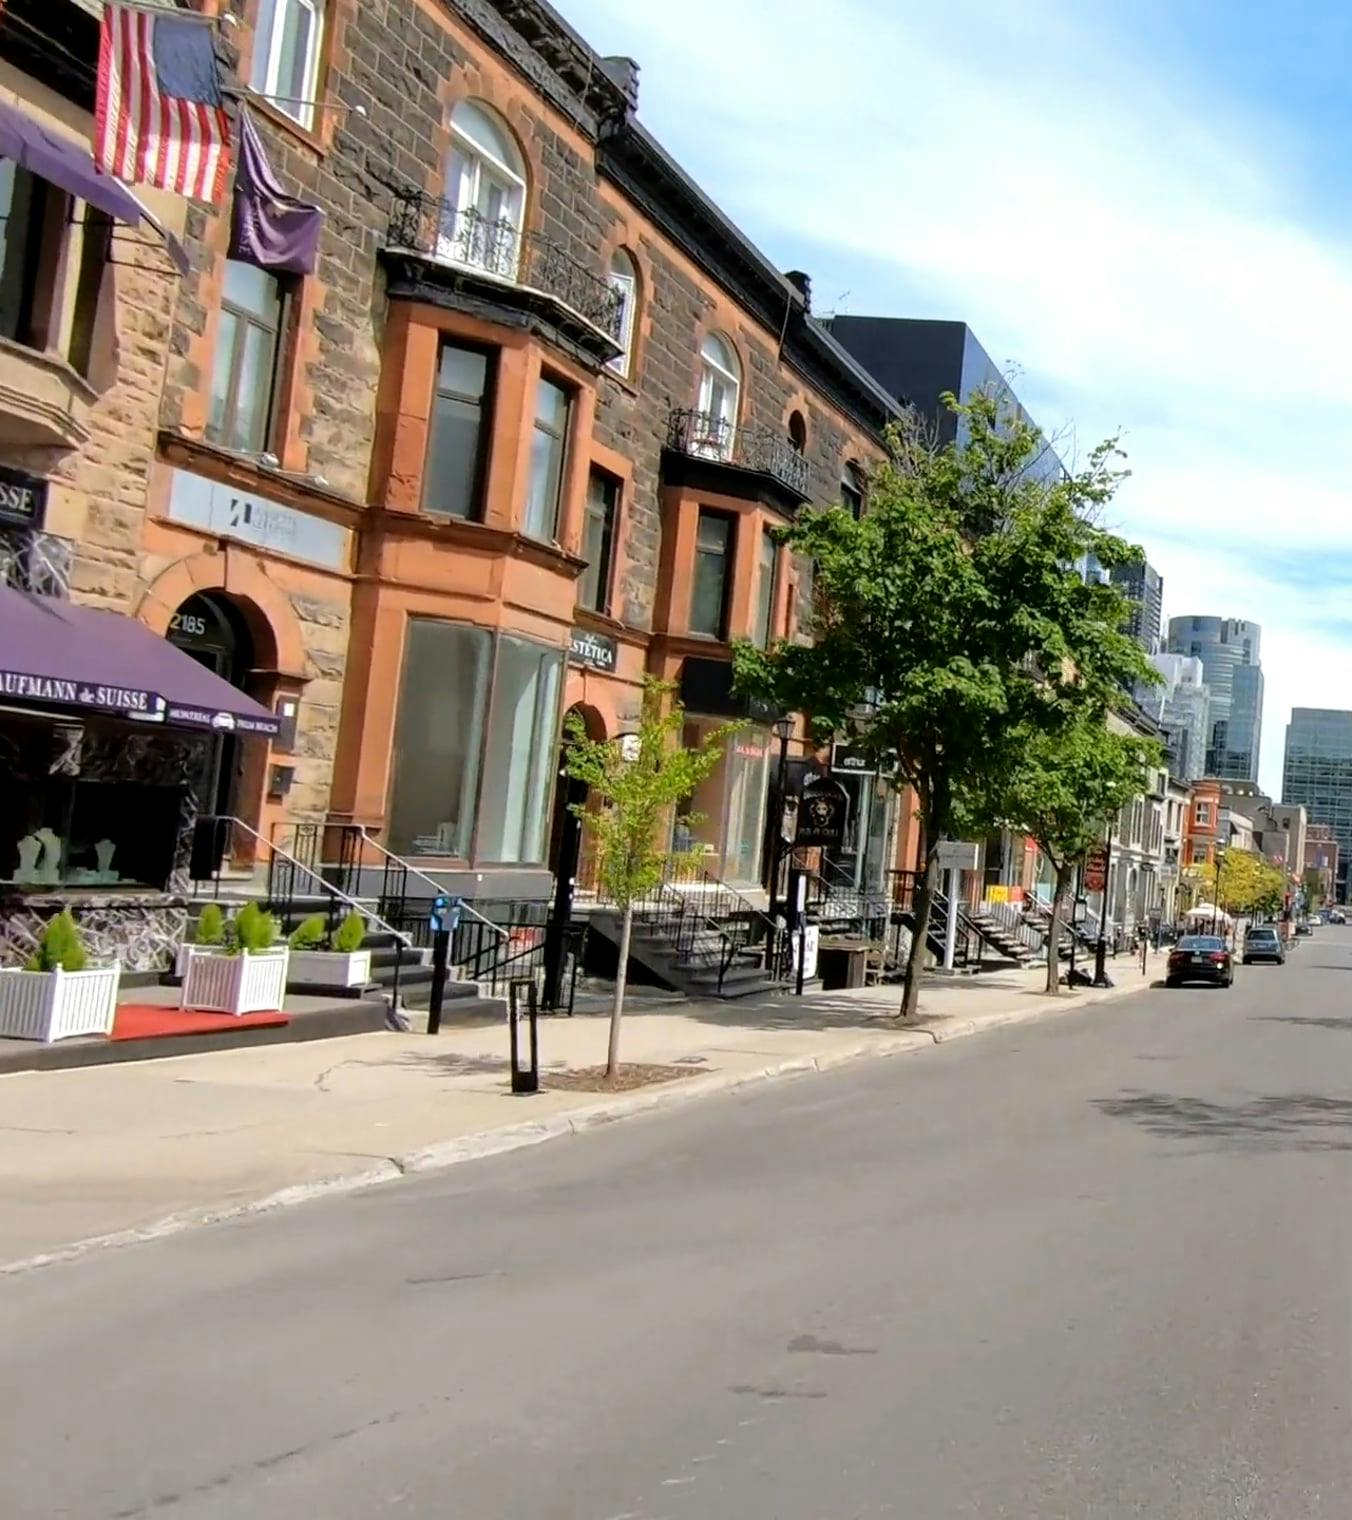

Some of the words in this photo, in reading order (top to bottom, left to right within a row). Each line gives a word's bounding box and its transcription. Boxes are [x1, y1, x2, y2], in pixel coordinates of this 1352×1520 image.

[170, 612, 206, 635] 2185
[79, 687, 94, 703] de
[97, 686, 148, 710] SUISSE
